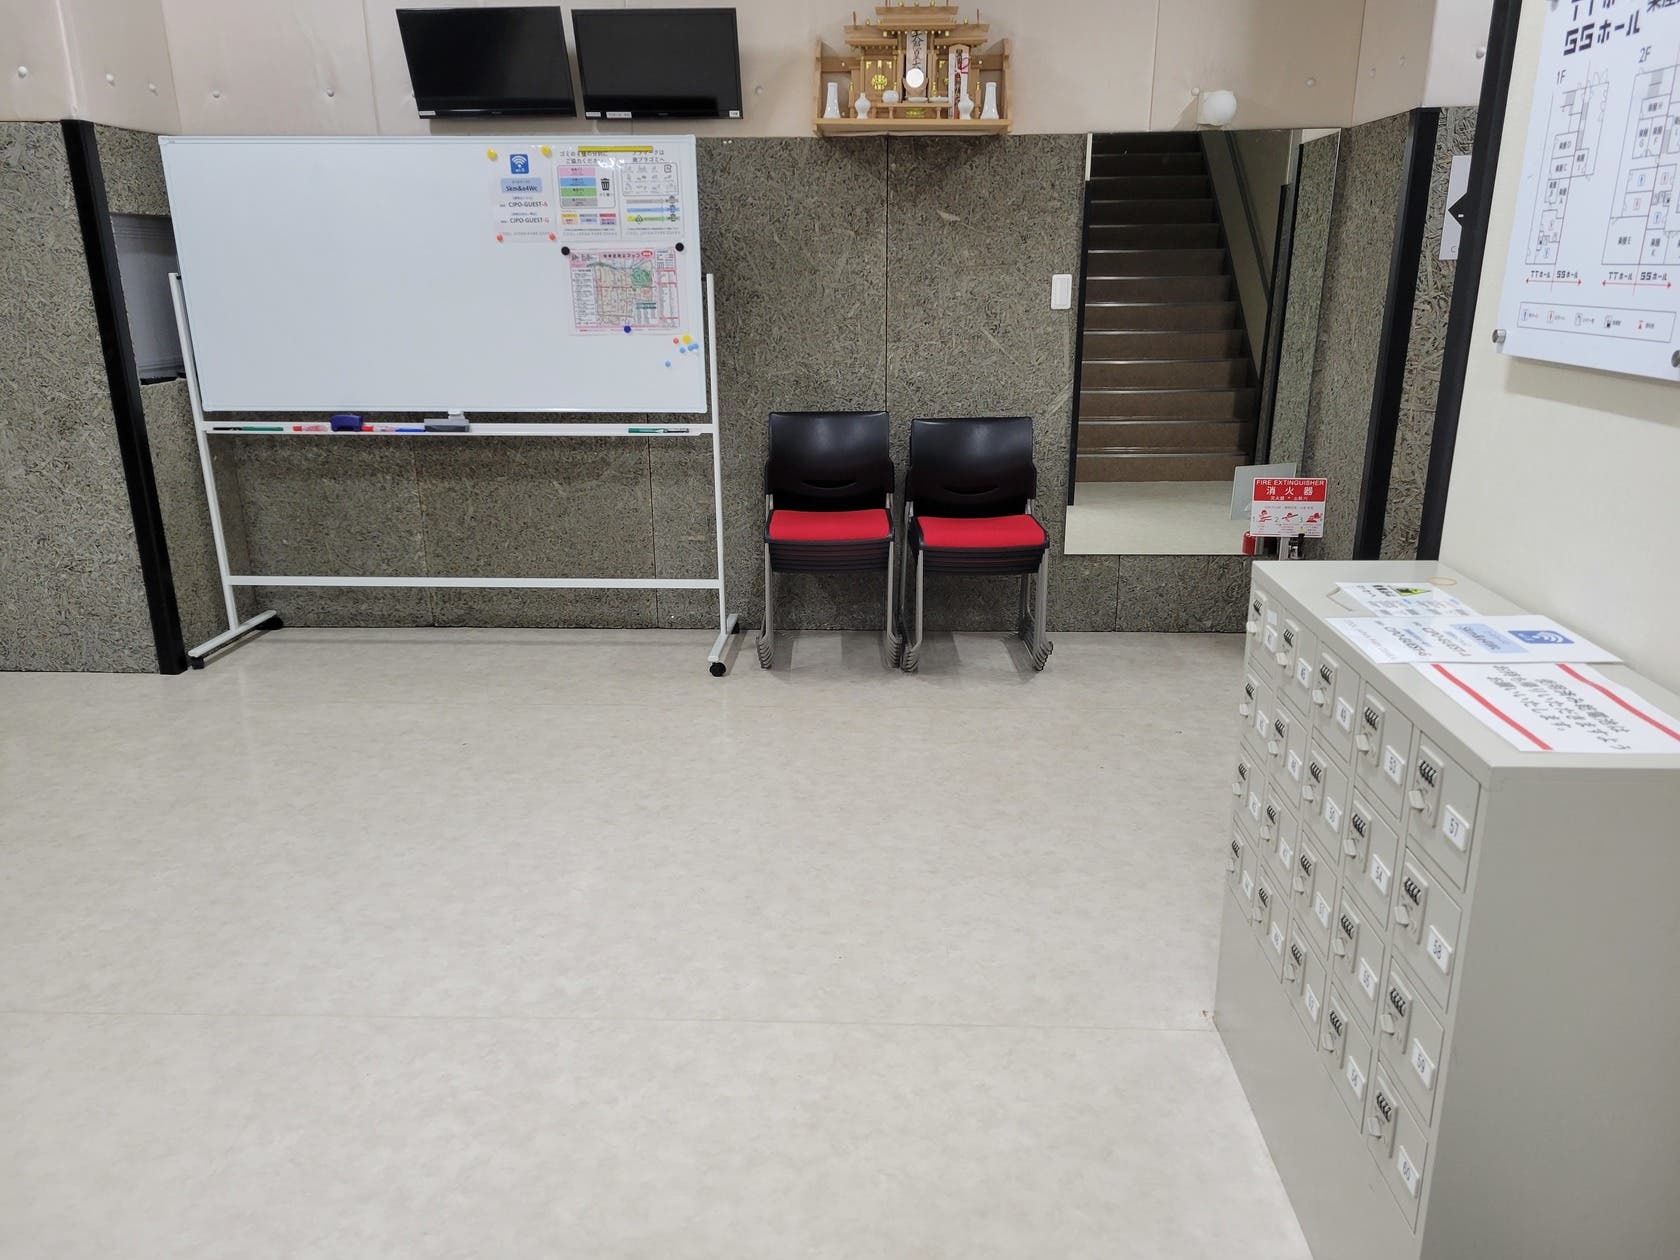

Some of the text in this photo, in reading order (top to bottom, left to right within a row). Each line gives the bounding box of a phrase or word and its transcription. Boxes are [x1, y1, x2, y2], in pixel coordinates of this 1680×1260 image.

[1563, 10, 1640, 56] SSホール
[1638, 46, 1651, 63] 2F
[1556, 69, 1567, 85] 1F
[1608, 271, 1632, 280] TTホール
[1640, 272, 1667, 281] SSホール
[1266, 486, 1313, 496] 消火器
[1449, 818, 1459, 837] 57
